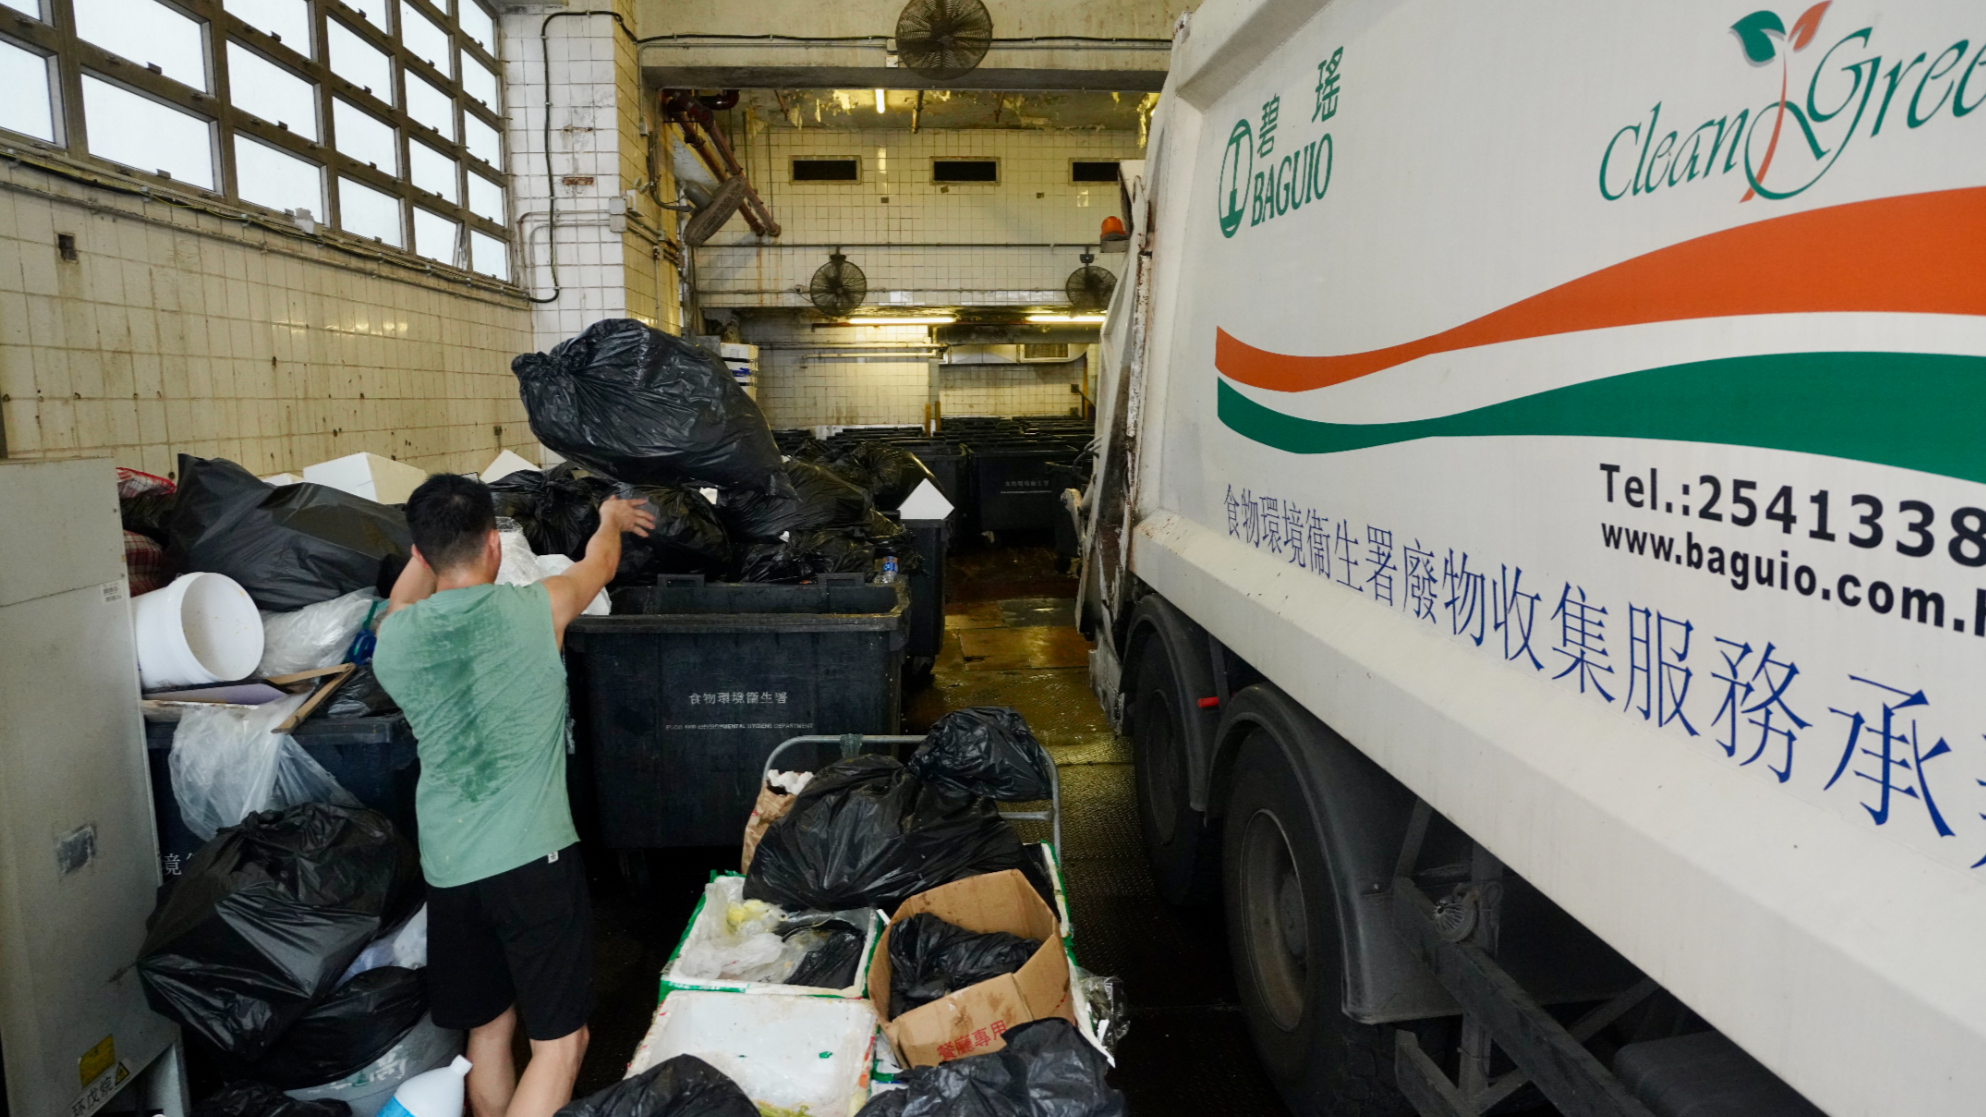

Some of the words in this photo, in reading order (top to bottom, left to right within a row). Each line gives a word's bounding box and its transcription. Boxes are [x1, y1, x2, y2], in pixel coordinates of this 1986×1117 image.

[1251, 133, 1333, 227] BAGUIO
[1598, 101, 1750, 201] Clean
[1223, 484, 1986, 869] 食物環境衞生署廢物收集服務承
